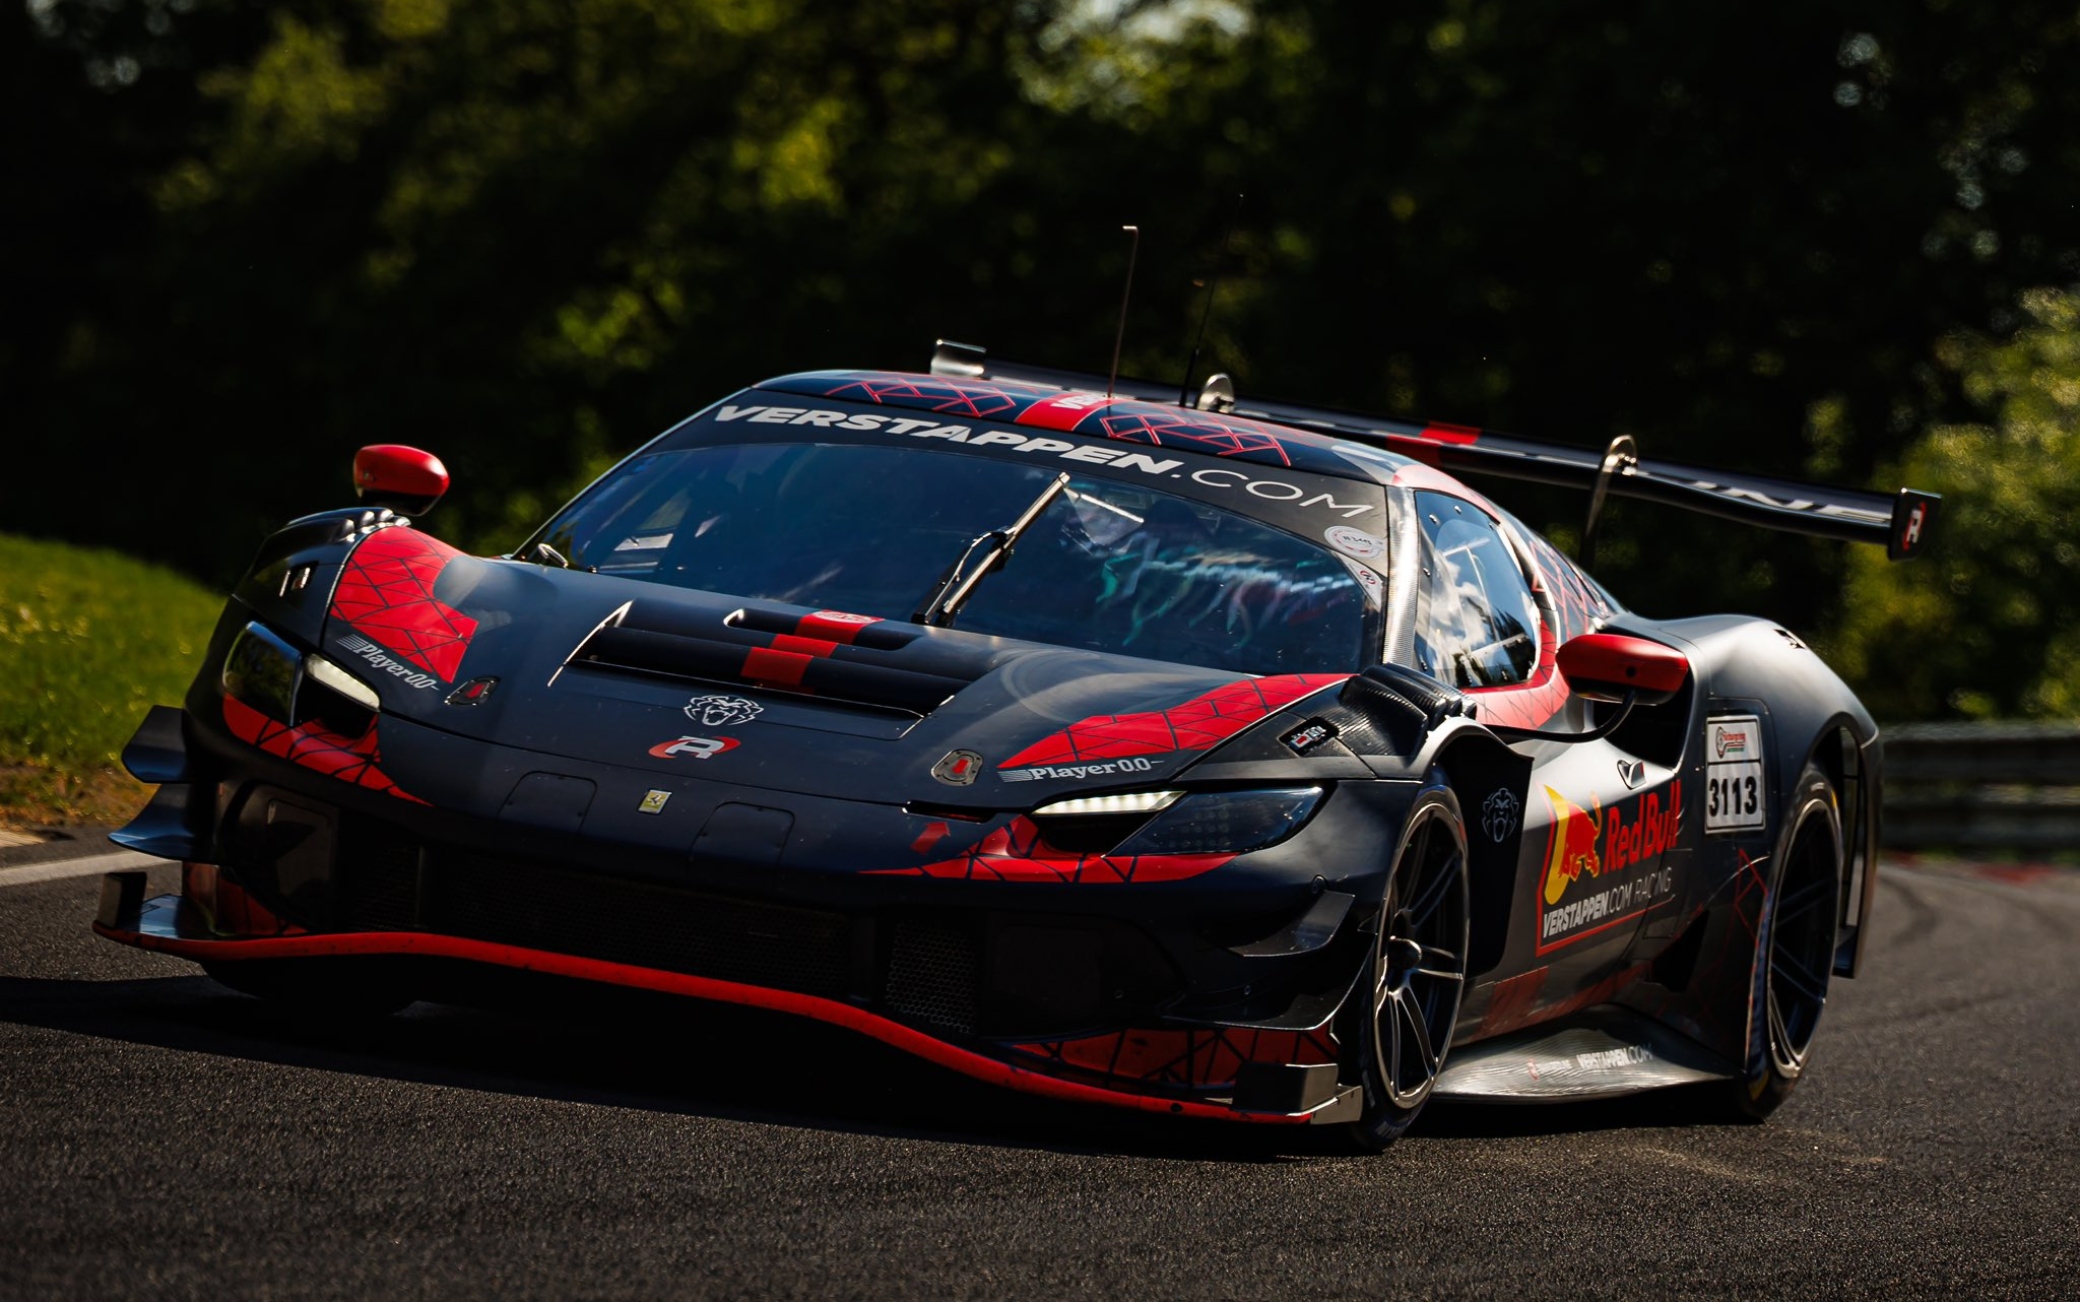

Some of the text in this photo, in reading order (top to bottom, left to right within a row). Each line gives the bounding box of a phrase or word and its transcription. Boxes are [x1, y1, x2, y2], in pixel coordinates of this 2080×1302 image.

[715, 405, 1372, 517] VERSTAPPEN.COM
[354, 644, 414, 677] Player
[1031, 764, 1117, 780] Player
[1709, 776, 1757, 817] 3113
[1604, 779, 1681, 874] Red Bull
[1543, 867, 1673, 938] VERSTAPPEN.COM RACNG
